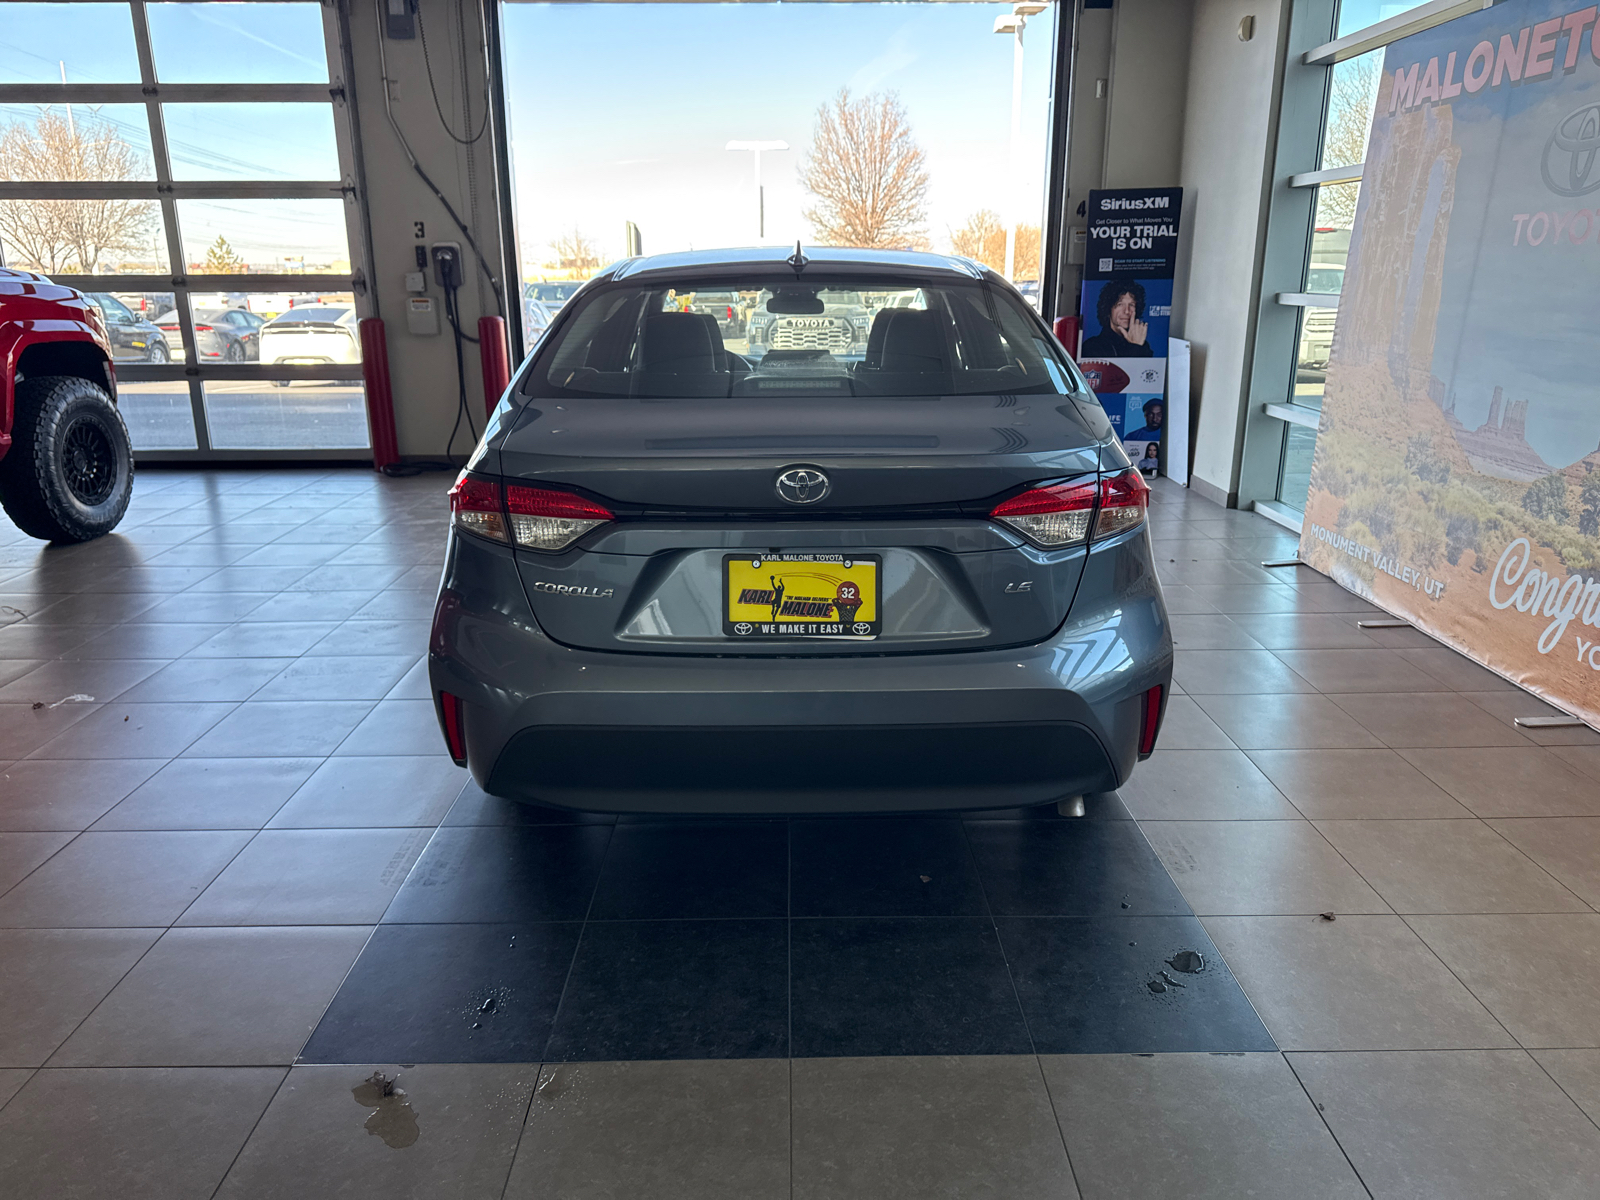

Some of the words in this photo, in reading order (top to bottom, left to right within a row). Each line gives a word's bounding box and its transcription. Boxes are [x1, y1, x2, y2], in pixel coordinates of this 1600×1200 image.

[1388, 5, 1600, 114] MALONET
[1076, 200, 1086, 217] 4
[1100, 197, 1169, 210] SiriusXM
[414, 221, 425, 238] 3
[1090, 226, 1131, 239] YOUR
[1134, 225, 1177, 237] TRIAL
[1512, 208, 1600, 247] TOYO
[1112, 238, 1127, 250] IS
[1129, 238, 1152, 250] ON
[791, 319, 830, 328] TOYOTA
[1311, 523, 1370, 562] MONUMENT
[1373, 552, 1420, 591] VALLEY,
[1424, 577, 1443, 598] UT
[533, 581, 614, 598] COROLLA
[841, 587, 855, 599] 32
[1004, 581, 1033, 593] LE
[737, 588, 774, 605] KARL
[779, 600, 834, 618] MALONE
[761, 624, 776, 634] WE
[779, 624, 805, 634] MAKE
[808, 624, 817, 634] IT
[820, 624, 844, 634] EASY
